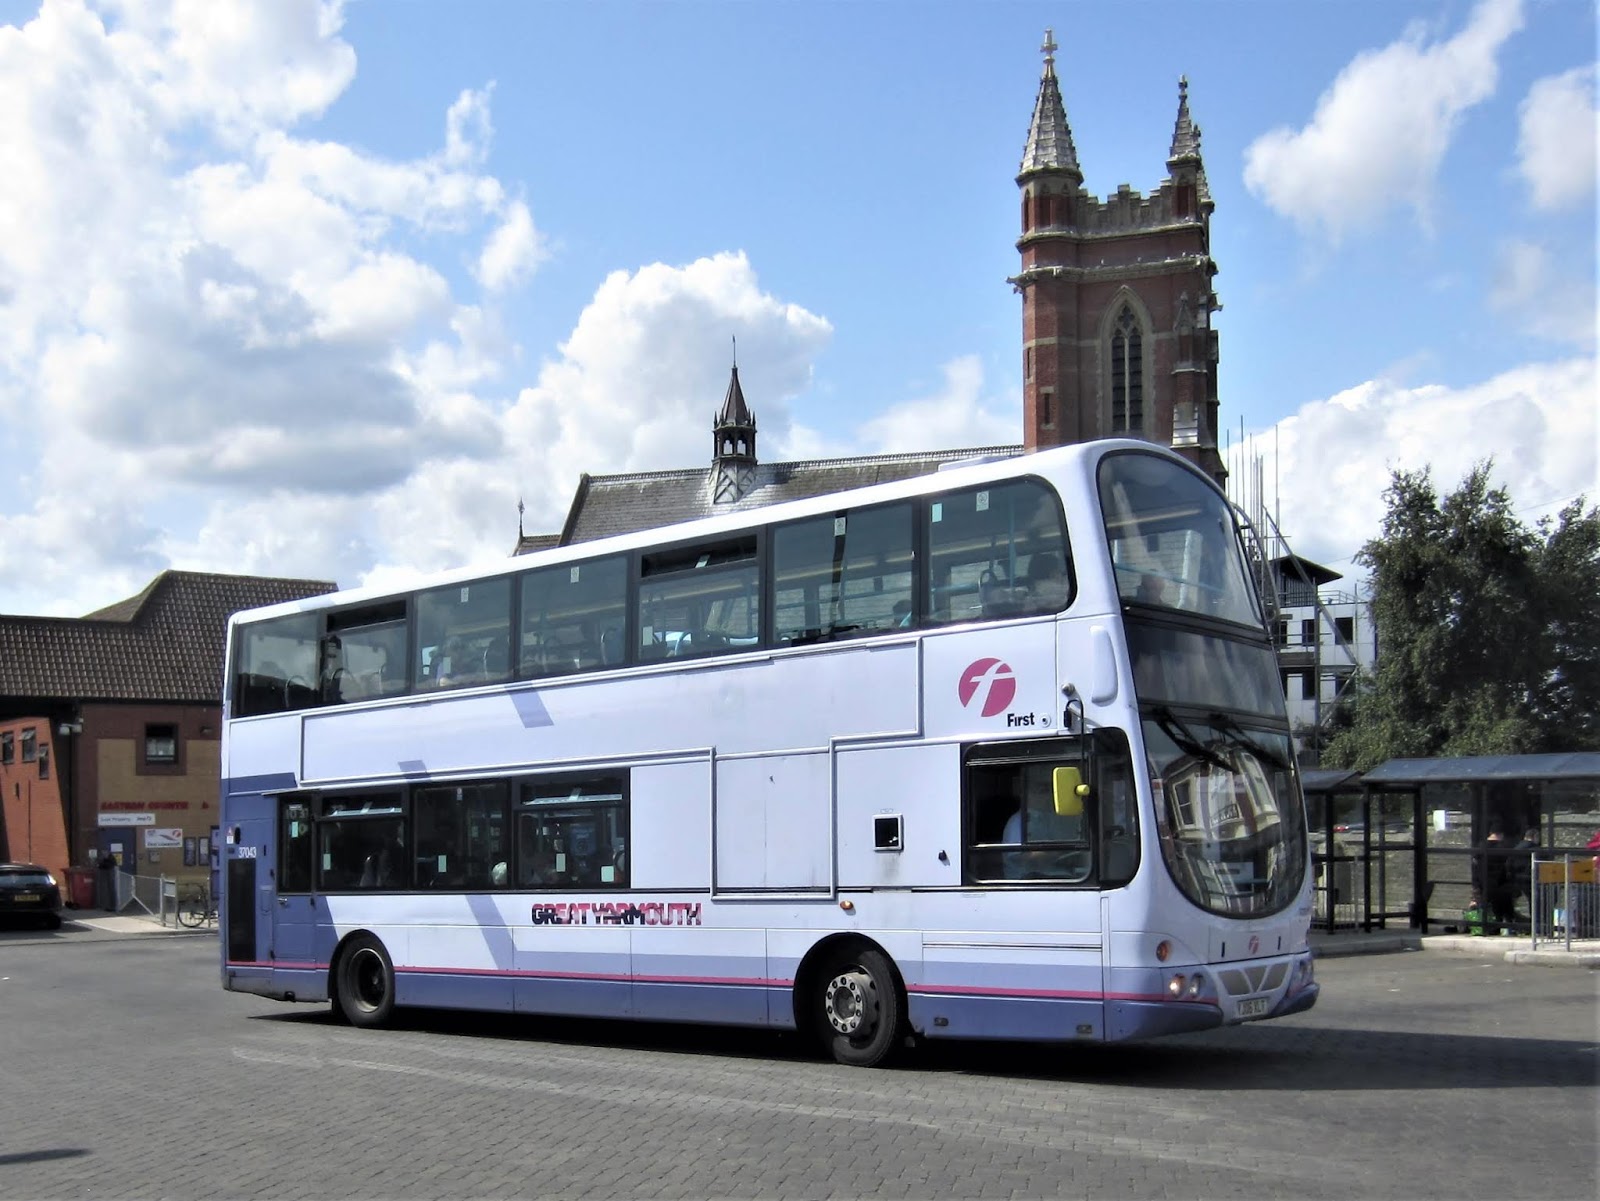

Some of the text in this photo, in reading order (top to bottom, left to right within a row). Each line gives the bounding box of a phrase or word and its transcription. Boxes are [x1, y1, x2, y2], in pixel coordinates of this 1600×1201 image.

[1007, 712, 1035, 727] First
[239, 846, 257, 859] 37043
[532, 903, 702, 926] GREAT YARMOUTH
